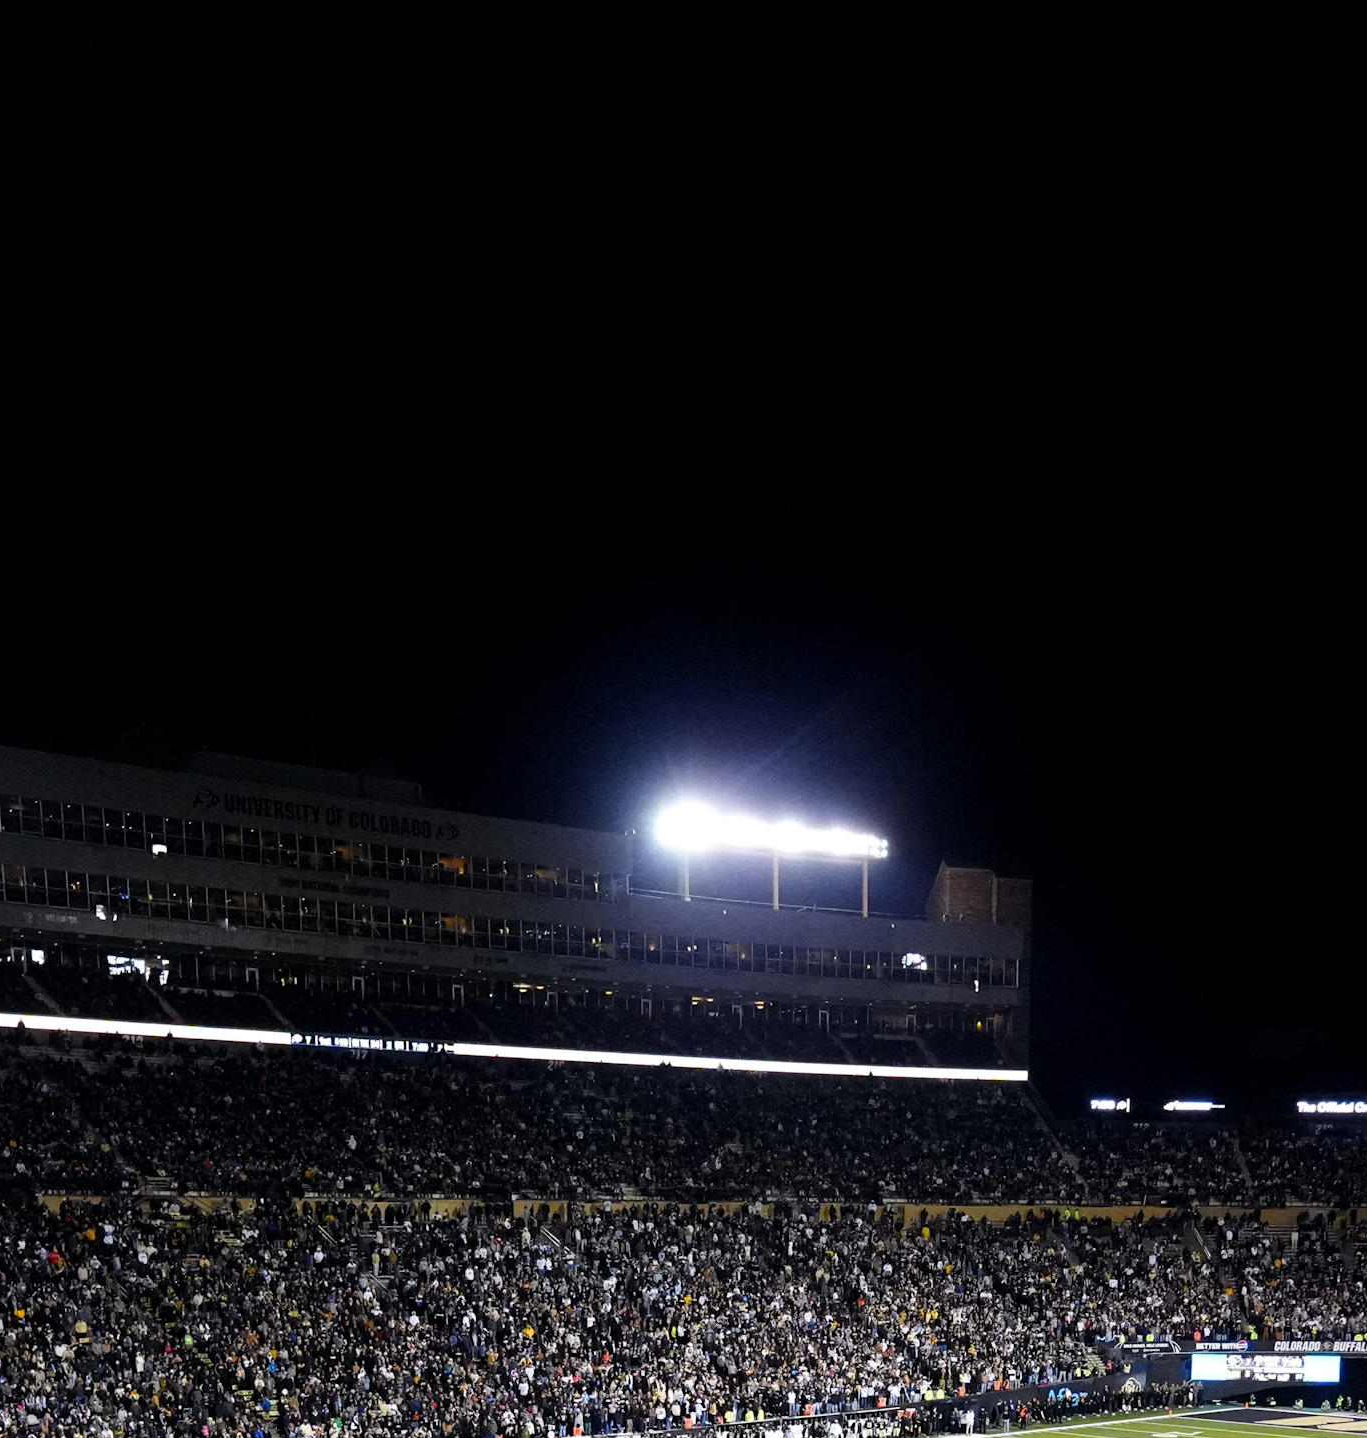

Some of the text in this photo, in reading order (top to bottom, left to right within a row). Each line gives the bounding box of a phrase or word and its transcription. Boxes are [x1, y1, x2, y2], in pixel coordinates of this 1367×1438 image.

[224, 793, 431, 838] UNIVERSITY OF COLORADO
[1297, 1101, 1316, 1113] The
[1196, 1342, 1238, 1350] BETTER WITH
[1274, 1341, 1320, 1351] COLORADO
